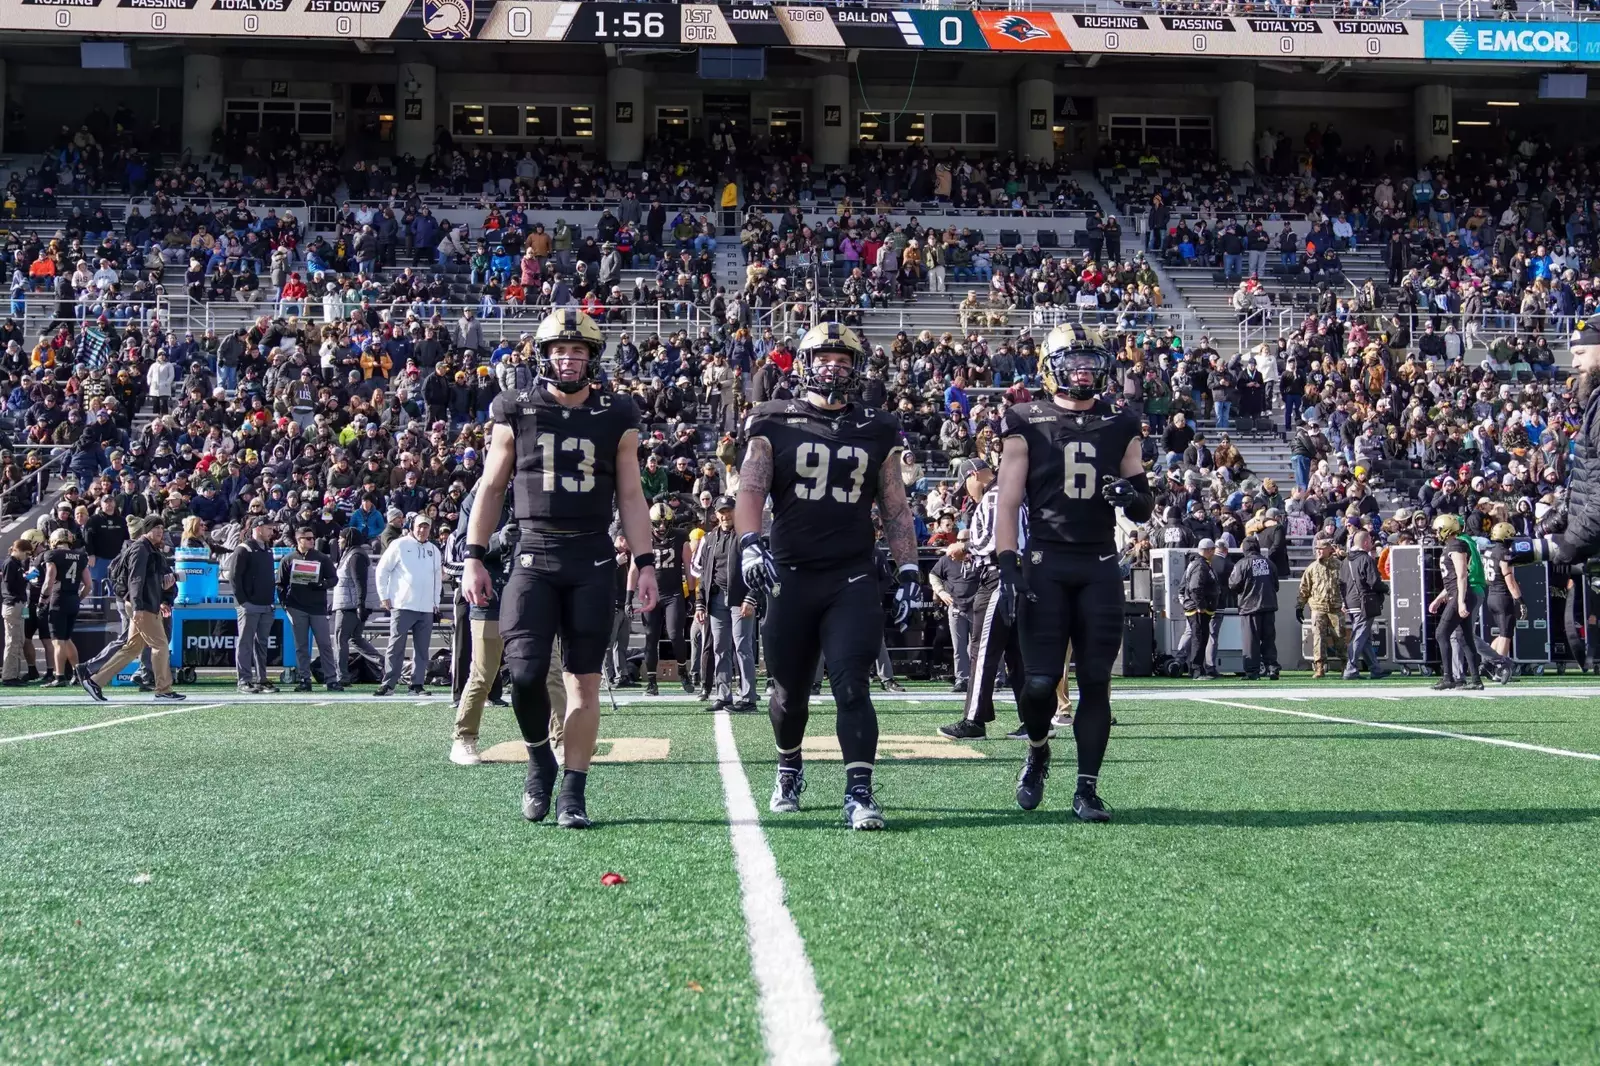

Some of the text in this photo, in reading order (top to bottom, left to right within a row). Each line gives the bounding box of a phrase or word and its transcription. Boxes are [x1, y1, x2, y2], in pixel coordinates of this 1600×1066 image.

[131, 0, 186, 8] PASSING
[219, 0, 284, 10] TOTAL YDS
[310, 1, 380, 12] 1ST DOWNS
[56, 10, 71, 27] 0
[151, 12, 166, 30] 0
[508, 7, 532, 37] 0
[685, 9, 712, 23] 1ST
[732, 9, 769, 20] DOWN
[788, 10, 823, 21] TO GO
[838, 11, 888, 23] BALL ON
[1084, 16, 1138, 28] RUSHING
[243, 14, 259, 32] 0
[336, 16, 351, 34] 0
[595, 11, 665, 38] 1:56
[1172, 19, 1223, 30] PASSING
[1254, 20, 1315, 32] TOTAL YDS
[1339, 22, 1403, 34] 1ST DOWNS
[685, 26, 716, 40] QTR
[939, 16, 963, 46] 0
[1105, 32, 1119, 49] 0
[1193, 34, 1207, 51] 0
[1280, 36, 1294, 53] 0
[1367, 37, 1381, 54] 0
[1477, 29, 1572, 53] EMCOR
[406, 103, 421, 115] 12
[617, 107, 631, 118] 12
[1060, 96, 1079, 115] A
[600, 396, 611, 407] C
[864, 408, 875, 418] C
[537, 433, 596, 493] 13
[1063, 441, 1097, 500] 6
[794, 442, 869, 503] 93
[65, 561, 78, 584] 4
[187, 635, 277, 649] POWEE
